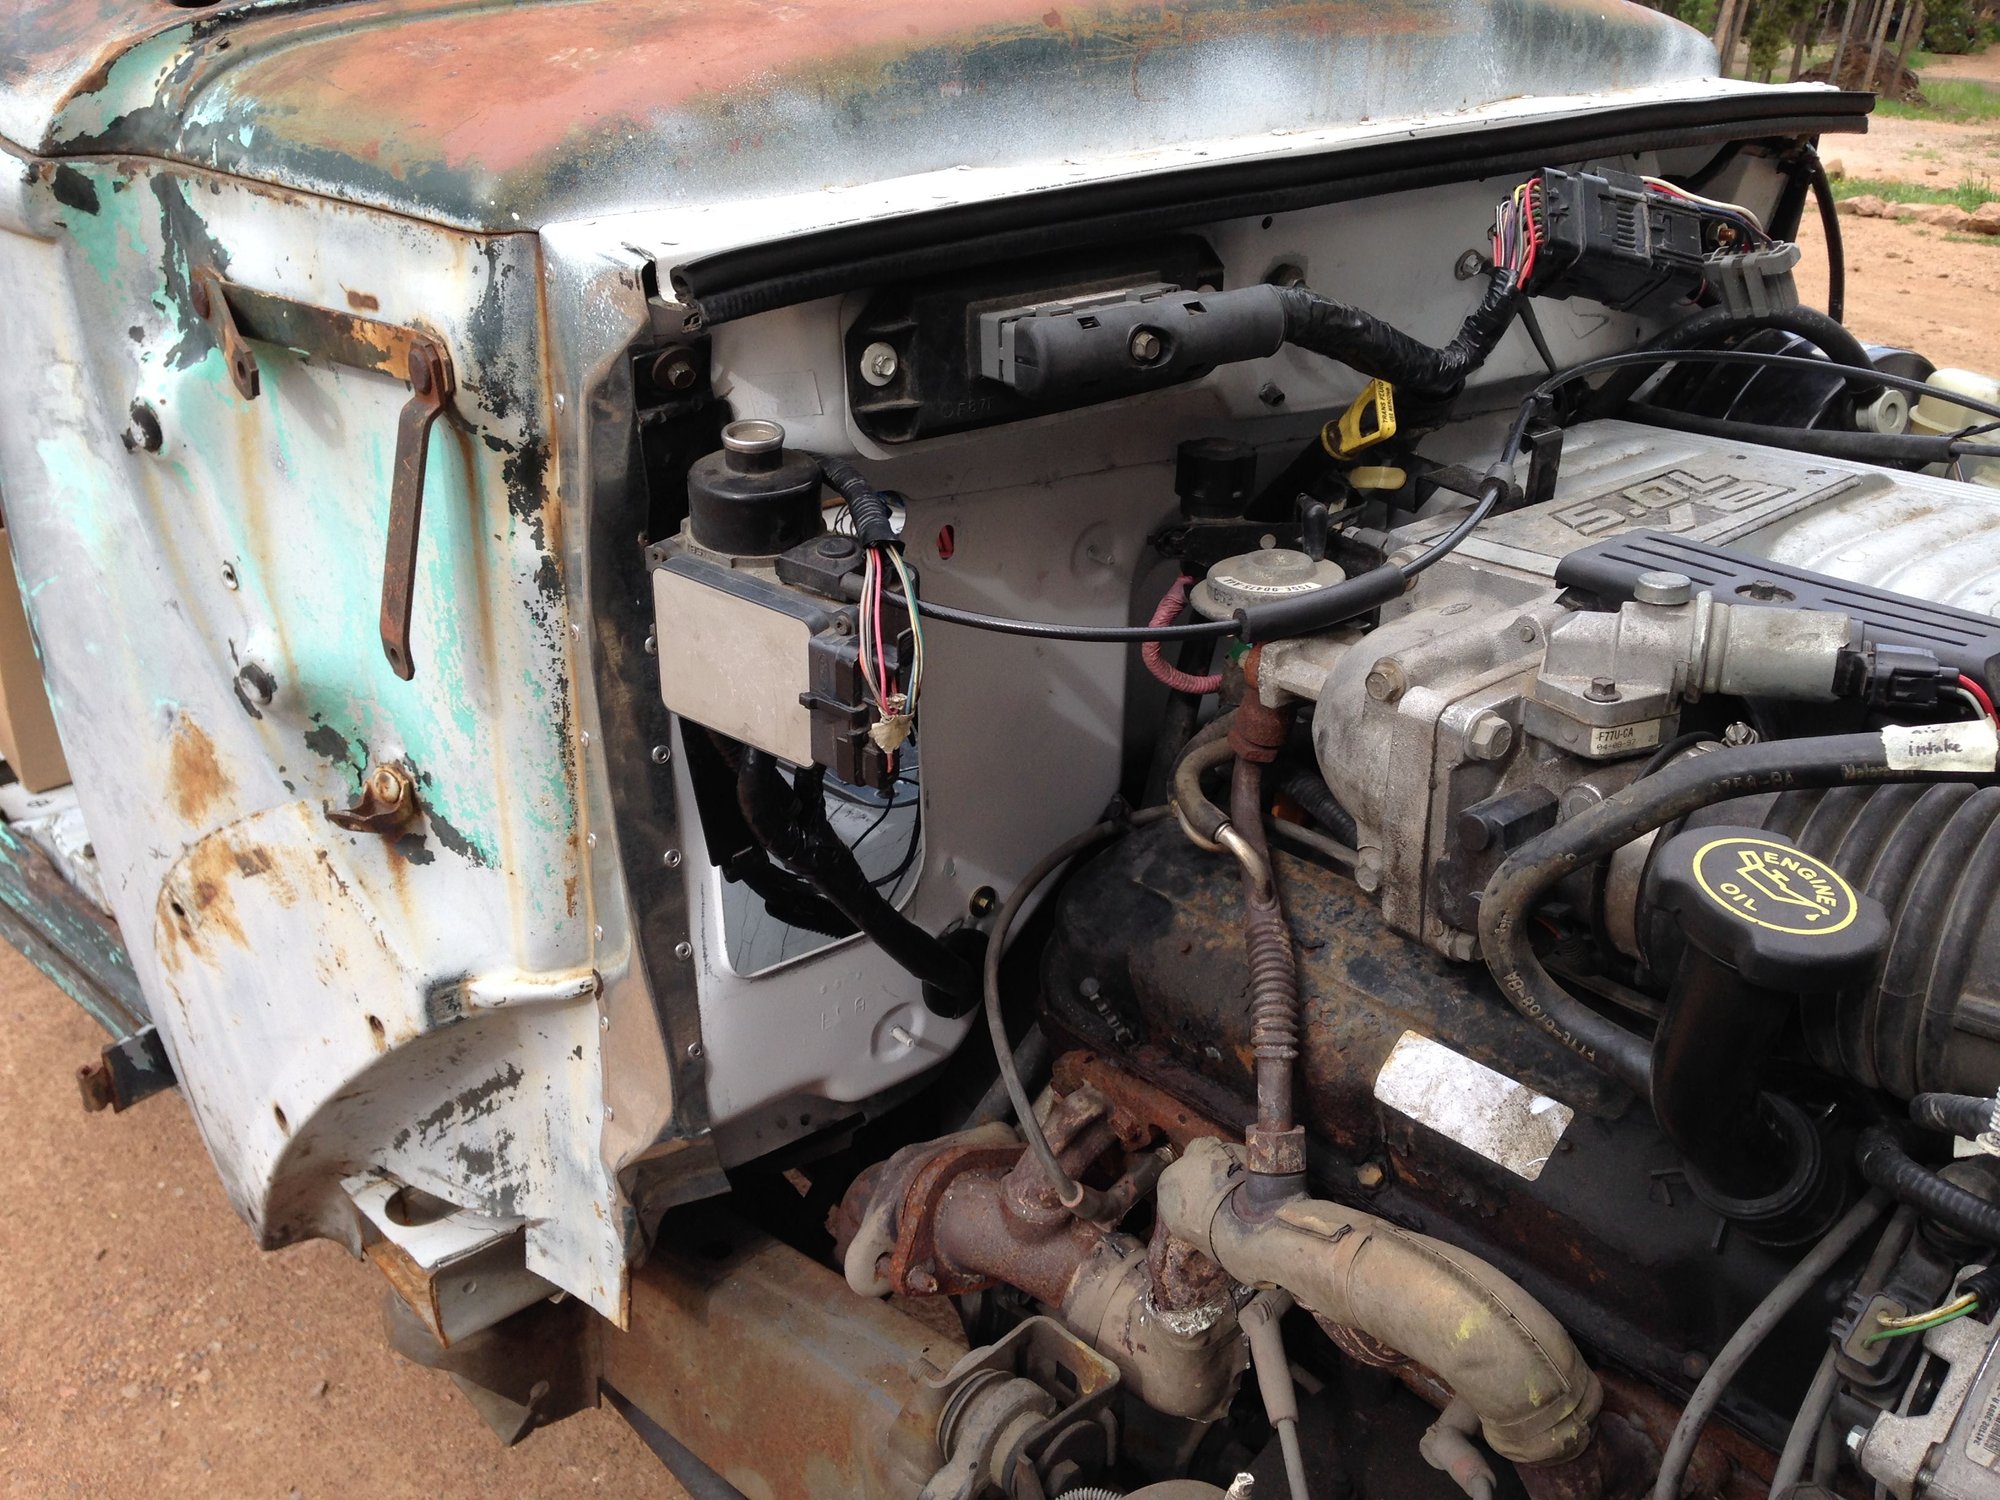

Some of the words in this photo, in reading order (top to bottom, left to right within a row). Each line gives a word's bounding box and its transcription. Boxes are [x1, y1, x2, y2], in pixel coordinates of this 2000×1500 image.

[1551, 470, 1739, 537] 5.0L
[1908, 738, 1963, 757] intake
[1720, 882, 1758, 912] OIL
[1763, 851, 1837, 907] ENGINE
